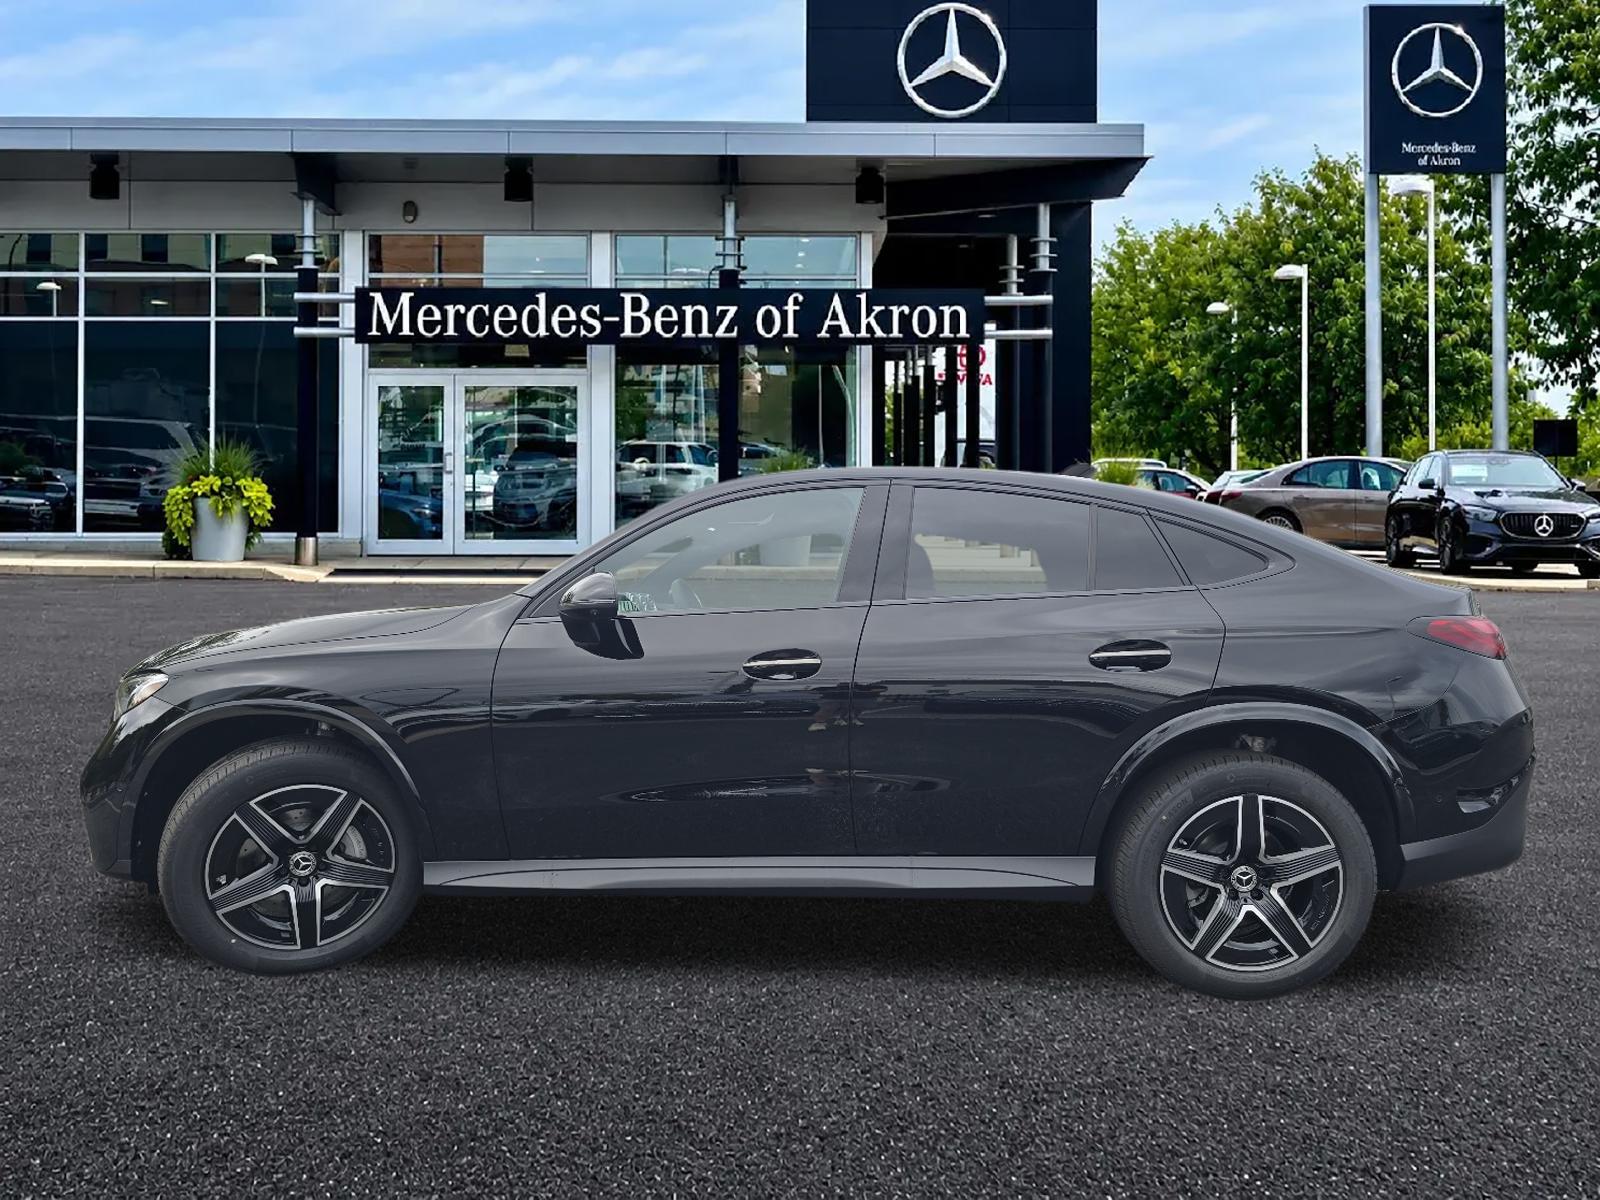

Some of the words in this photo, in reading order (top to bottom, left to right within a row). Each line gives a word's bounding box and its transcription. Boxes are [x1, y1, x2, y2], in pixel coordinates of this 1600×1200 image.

[1401, 142, 1476, 154] Mercedes-Benz
[1417, 155, 1429, 166] of
[1430, 155, 1461, 166] Akron
[367, 291, 738, 338] Mercedes-Benz
[755, 292, 804, 338] of
[816, 291, 971, 338] Akron
